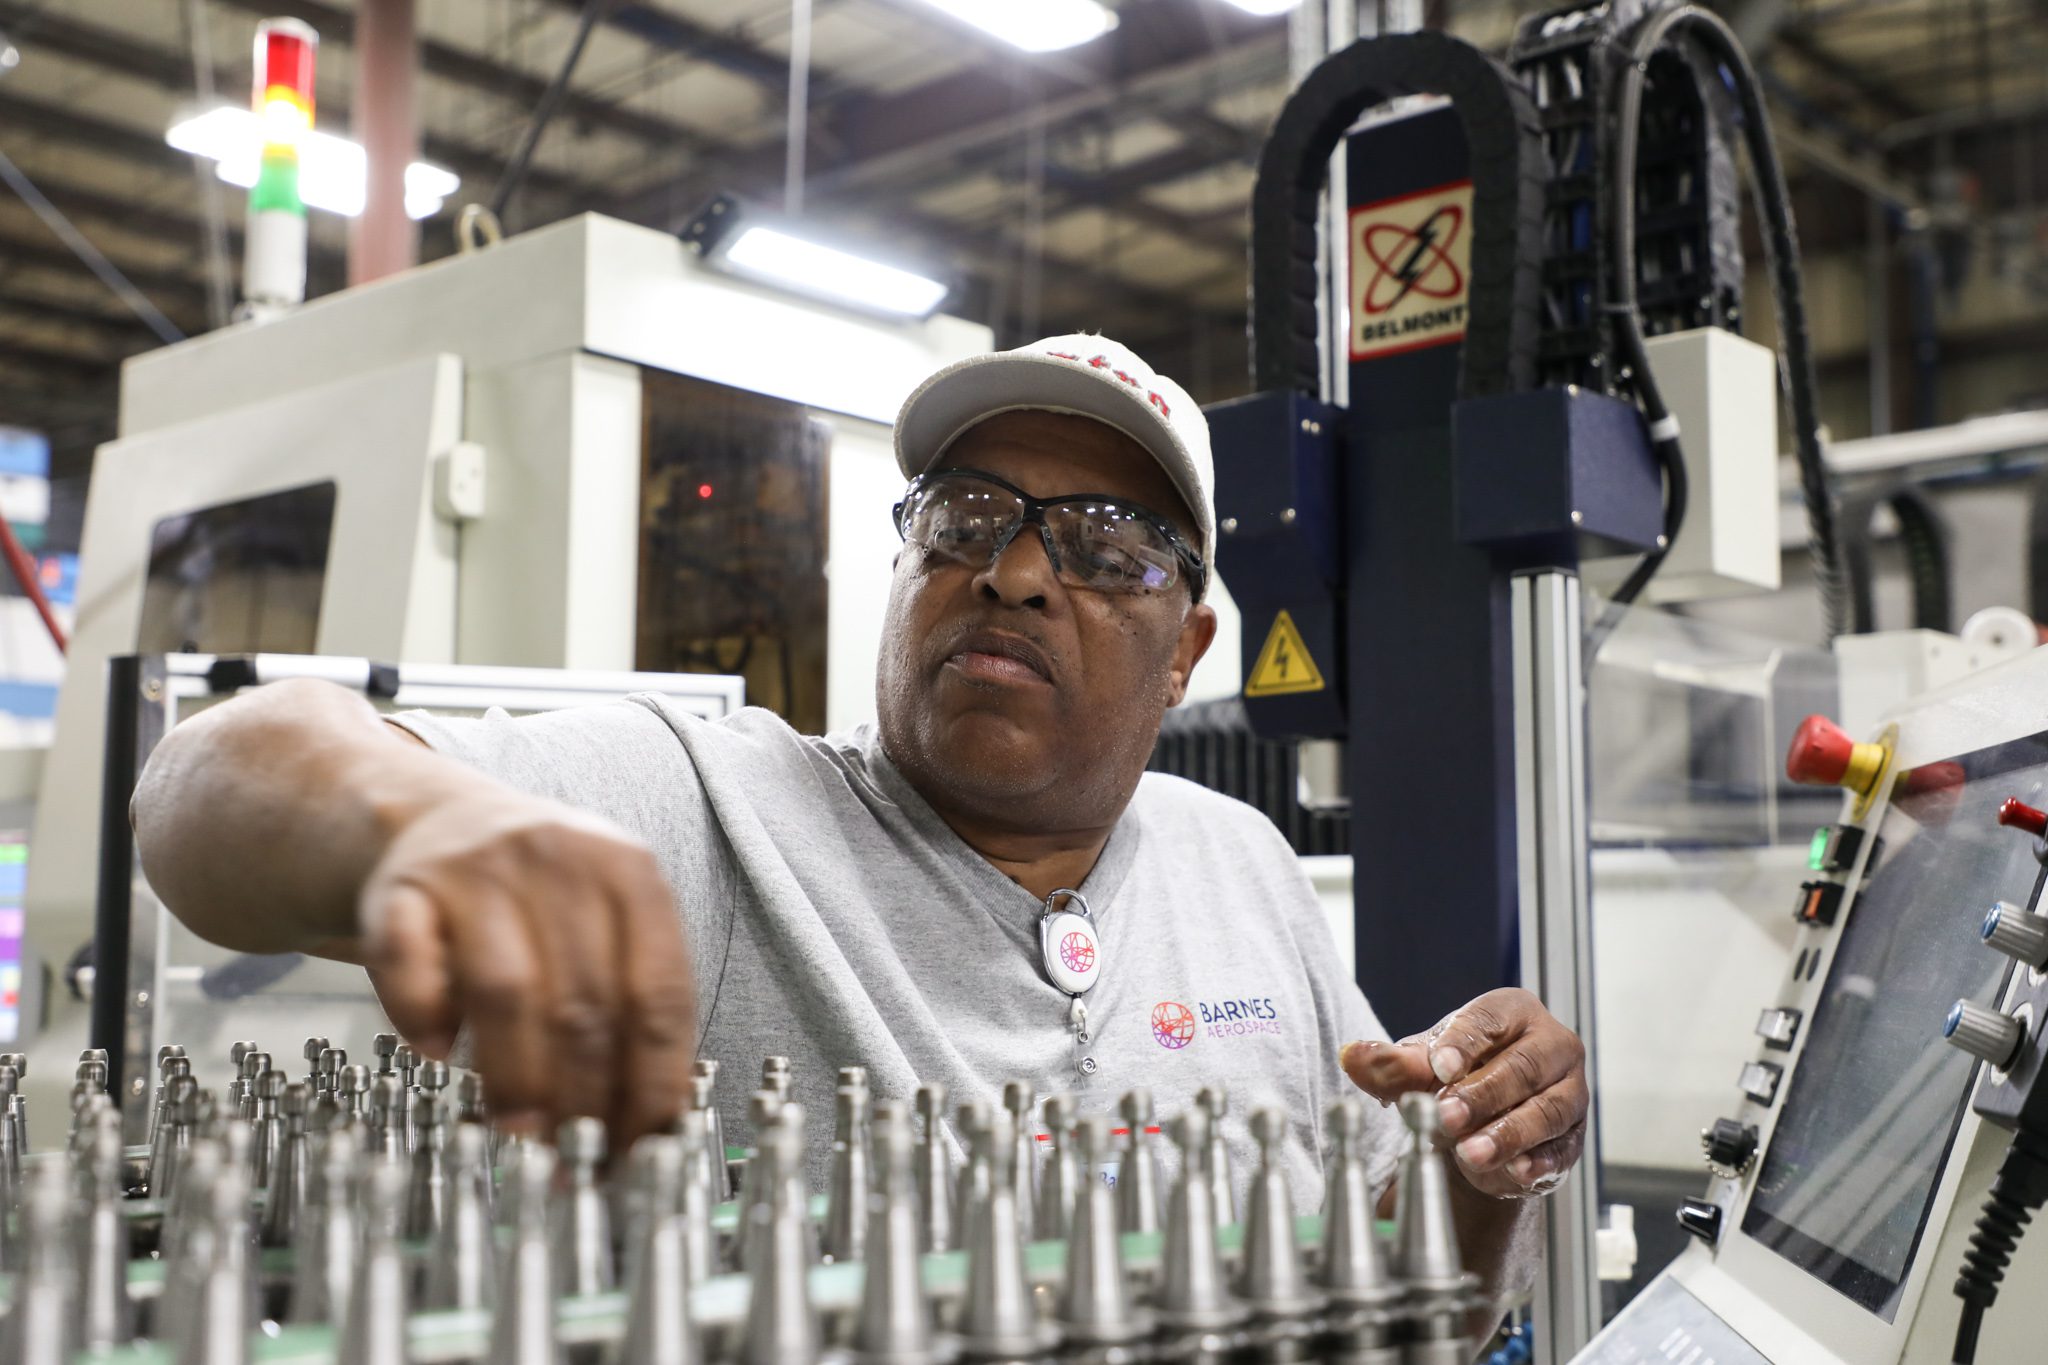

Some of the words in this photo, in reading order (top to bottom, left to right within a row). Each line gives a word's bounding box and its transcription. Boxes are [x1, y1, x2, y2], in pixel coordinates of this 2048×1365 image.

[1363, 304, 1466, 342] BELMONT
[1199, 998, 1276, 1023] BARNES
[1206, 1021, 1281, 1038] AEROSPACE
